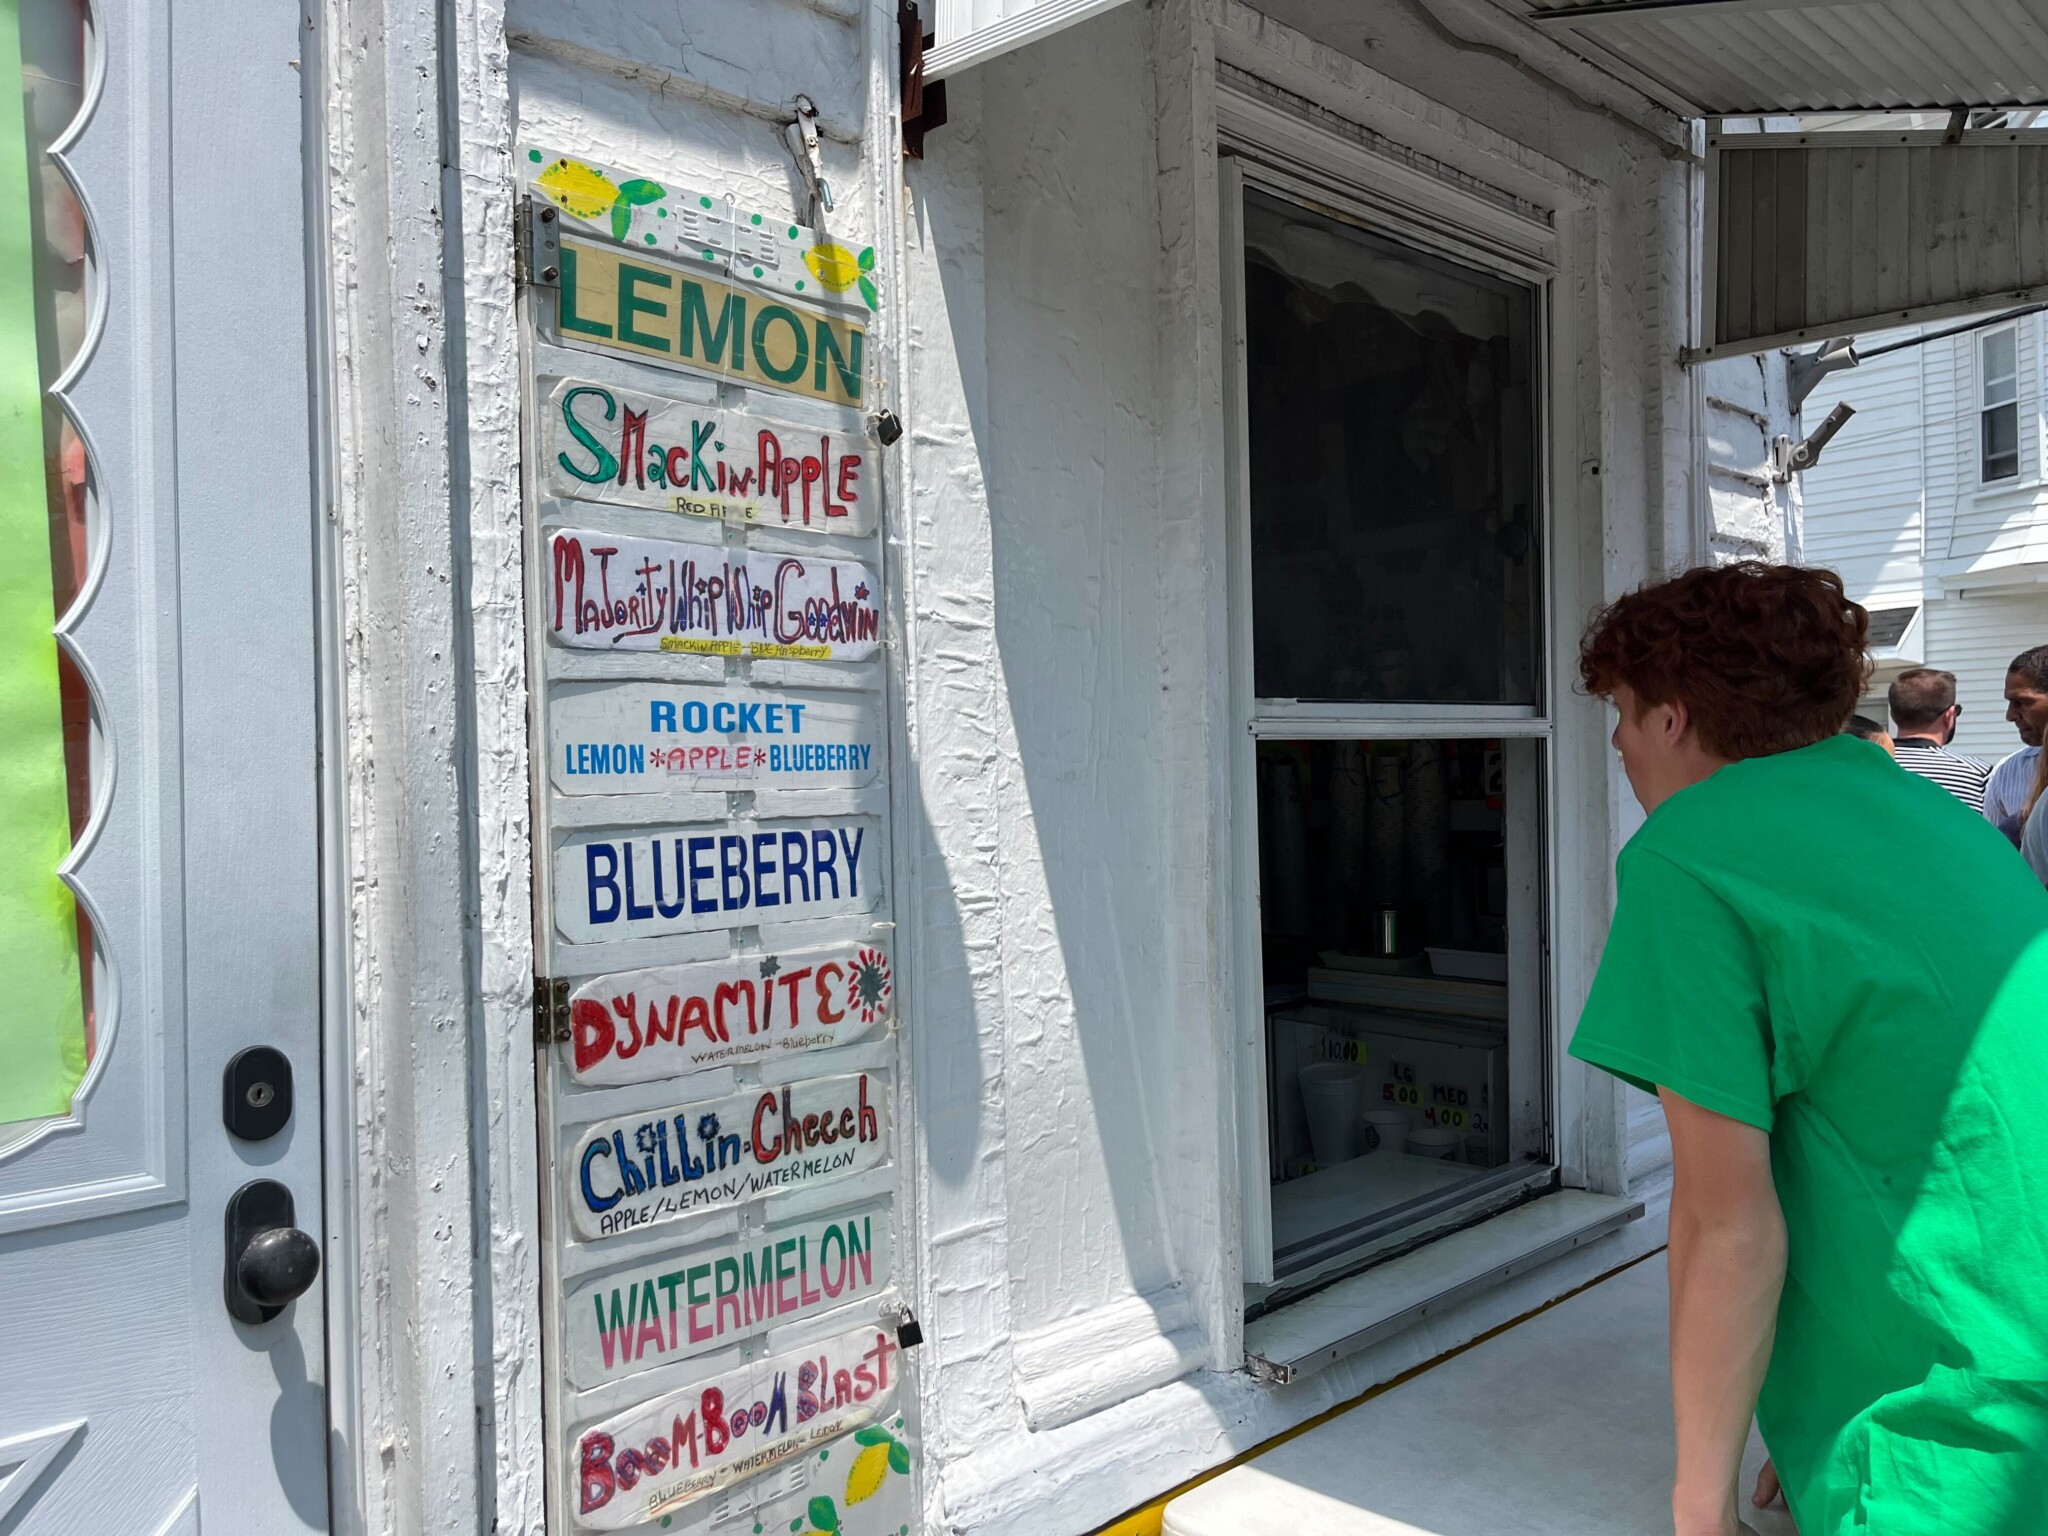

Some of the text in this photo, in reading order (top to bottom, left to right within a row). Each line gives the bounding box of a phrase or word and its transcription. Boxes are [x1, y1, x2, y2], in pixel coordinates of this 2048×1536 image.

[560, 247, 863, 399] LEMON
[650, 700, 806, 733] ROCKET
[565, 743, 645, 774] LEMON
[770, 743, 871, 772] BLUEBERRY
[586, 827, 864, 925] BLUEBERRY
[1394, 1063, 1413, 1084] LG
[1432, 1085, 1468, 1106] MED
[593, 1216, 873, 1371] WATERMELON
